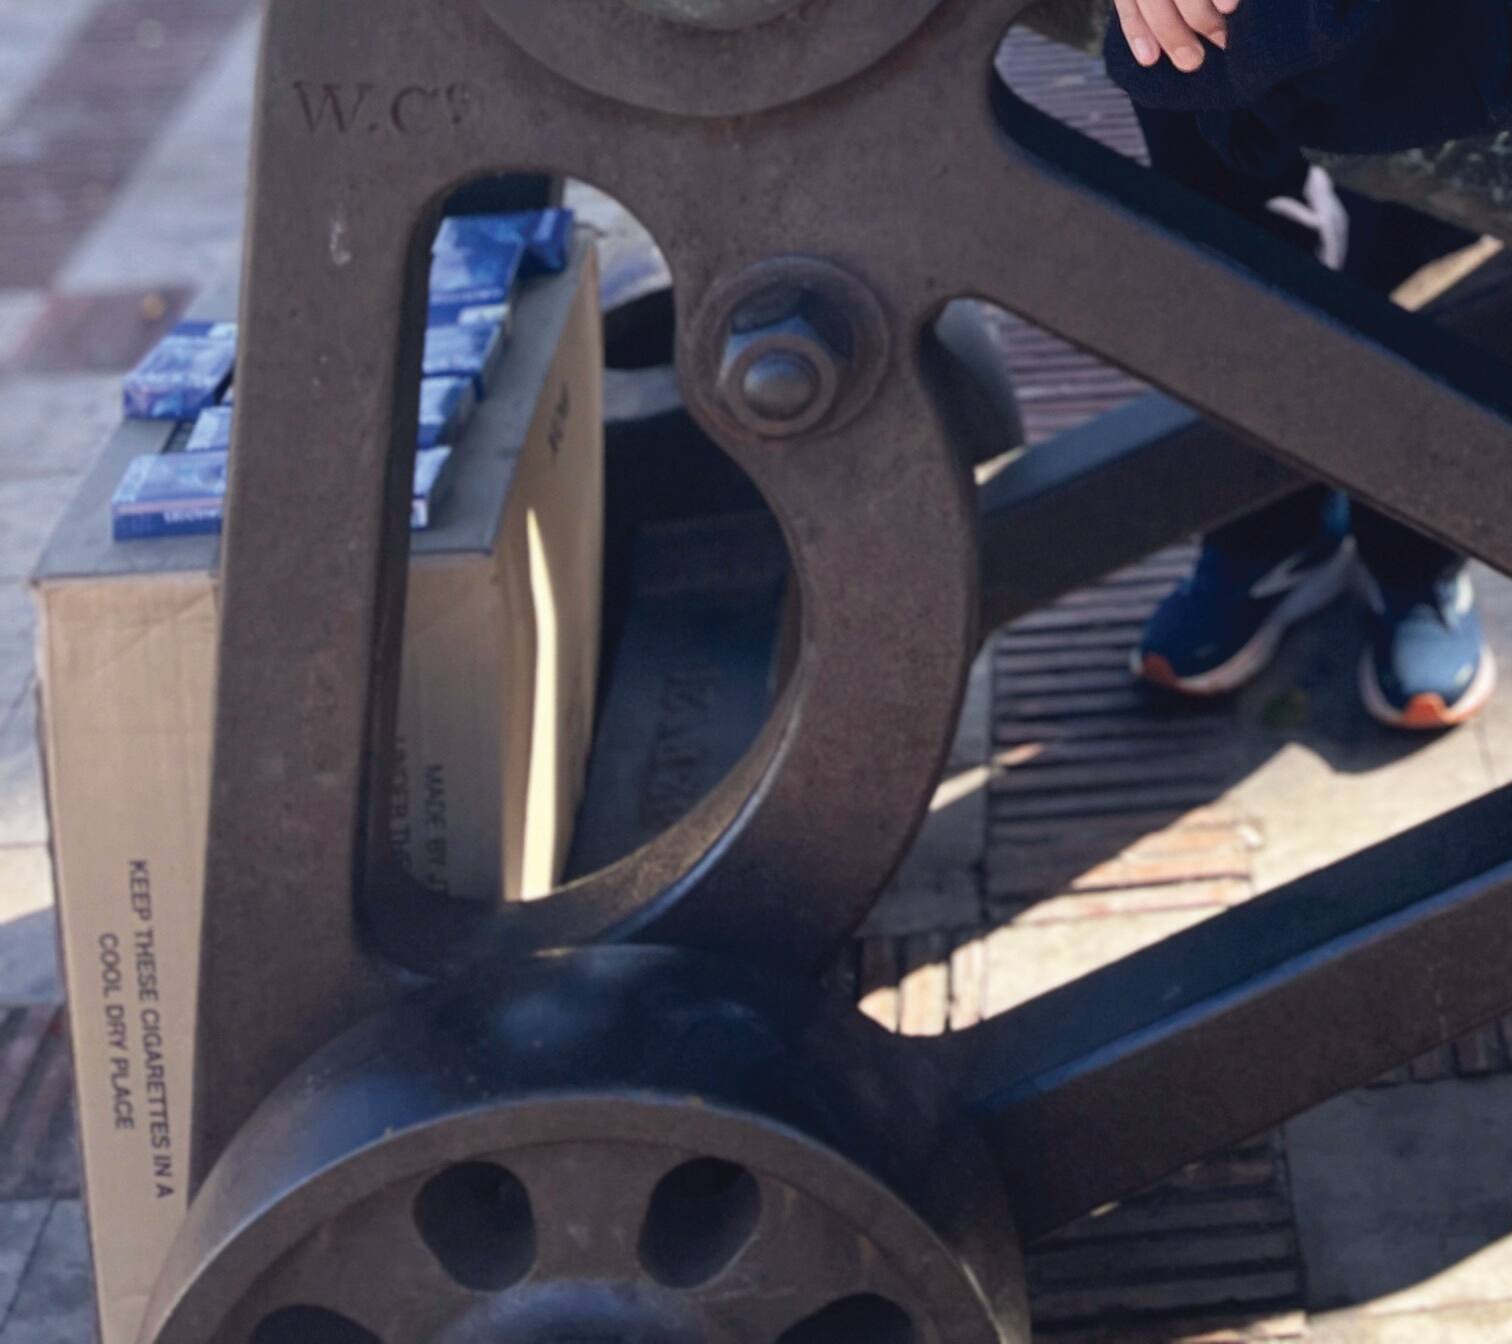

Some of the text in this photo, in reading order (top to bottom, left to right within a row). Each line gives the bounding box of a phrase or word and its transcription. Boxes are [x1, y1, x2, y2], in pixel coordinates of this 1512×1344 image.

[99, 932, 135, 1130] COOL DRY PLACE
[129, 860, 174, 1199] KEEP THESE CIGARETTES IN A
